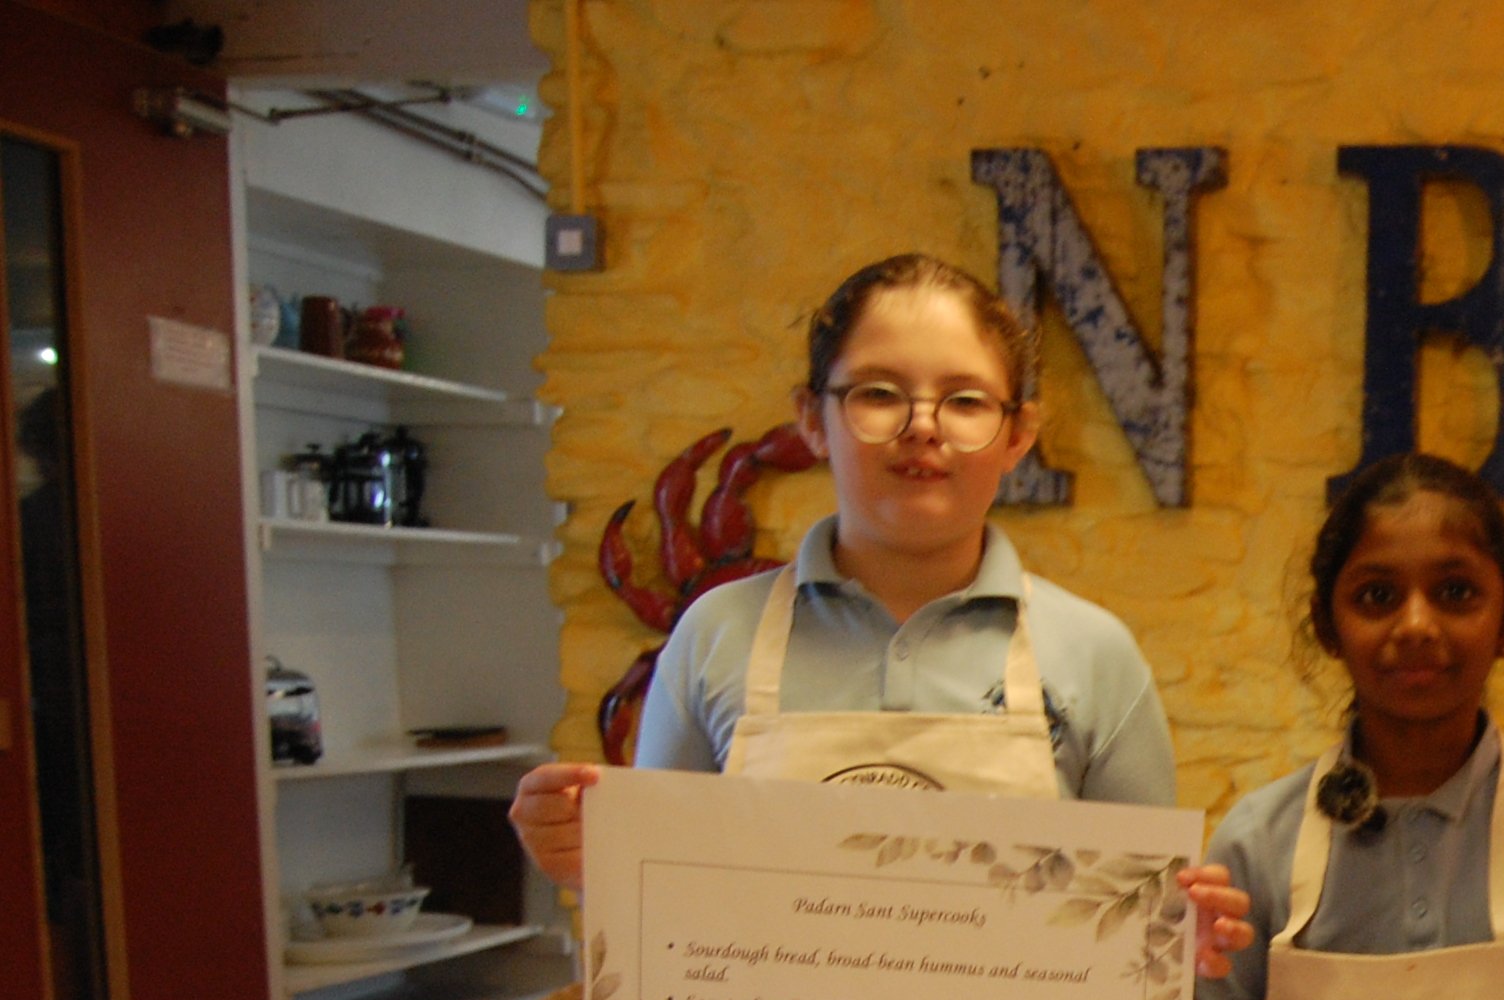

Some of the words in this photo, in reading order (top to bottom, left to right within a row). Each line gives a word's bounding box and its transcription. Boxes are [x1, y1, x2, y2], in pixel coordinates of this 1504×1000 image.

[793, 898, 851, 916] Padarn
[853, 903, 893, 919] Sant
[898, 904, 987, 928] Supercooks
[684, 942, 769, 965] Sourdough
[773, 945, 820, 967] bread,
[919, 956, 985, 977] hummus
[988, 961, 1022, 979] and
[1023, 967, 1093, 983] seasonal
[684, 966, 729, 983] salad.
